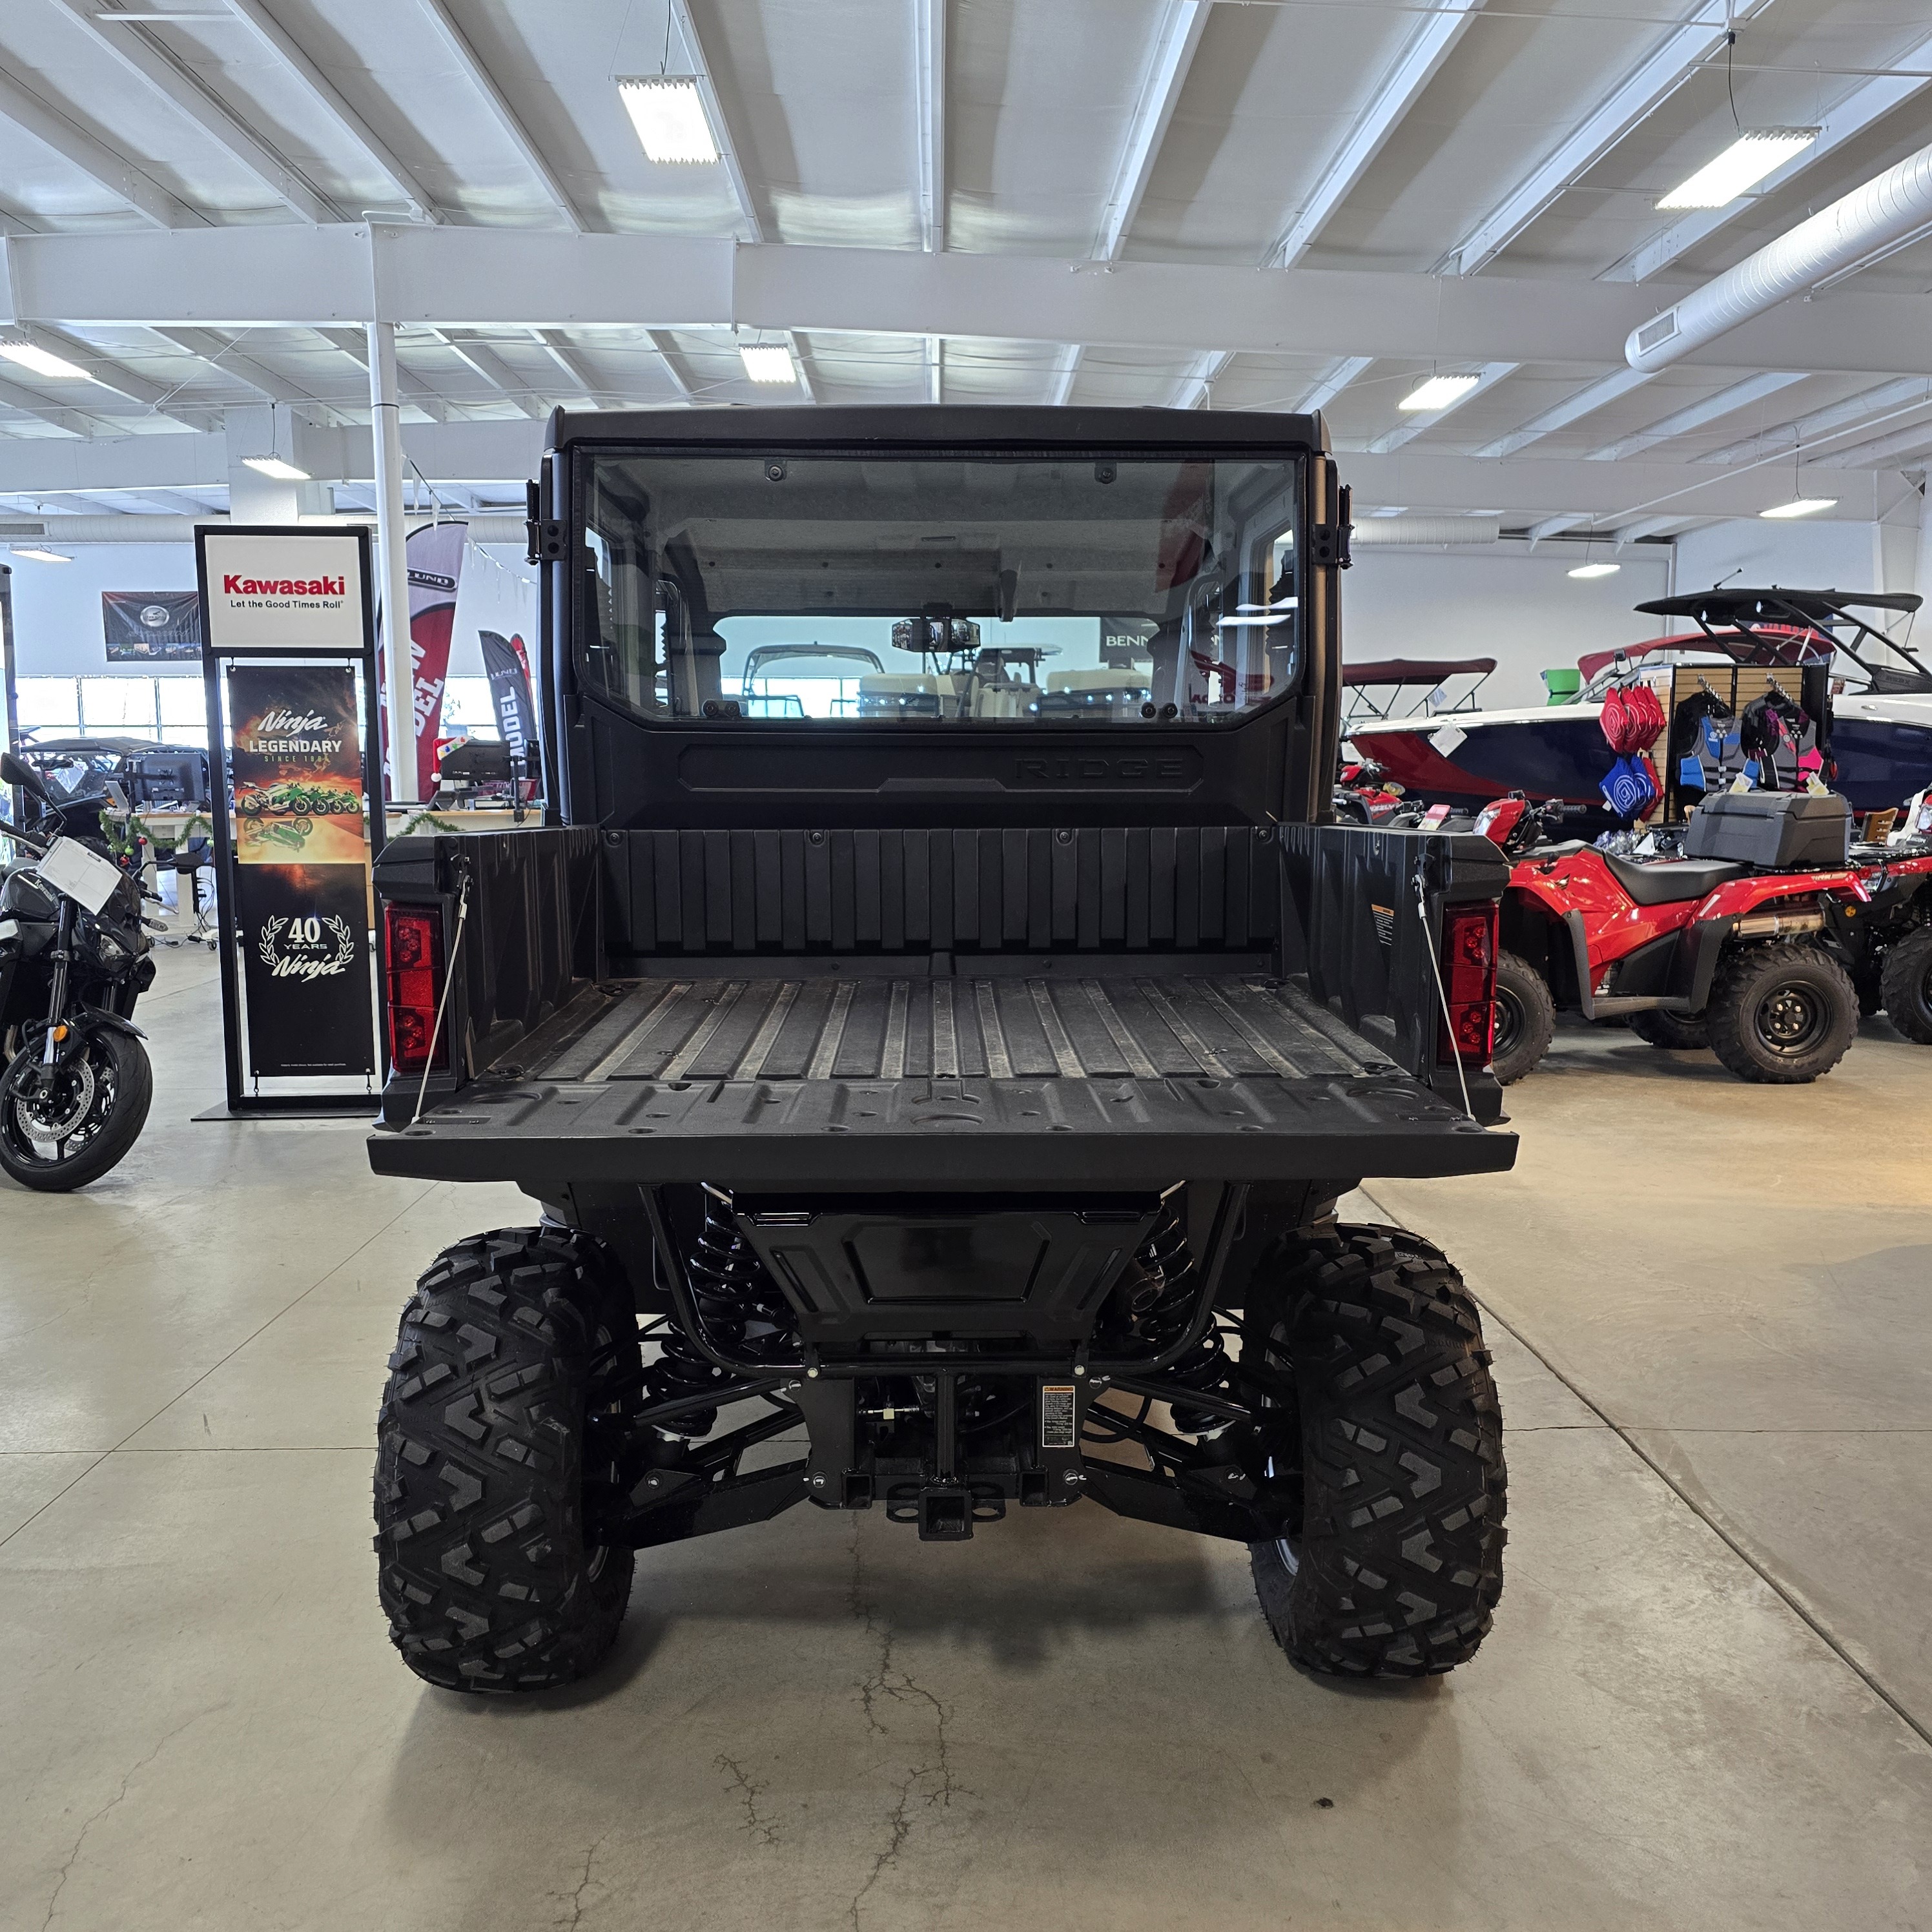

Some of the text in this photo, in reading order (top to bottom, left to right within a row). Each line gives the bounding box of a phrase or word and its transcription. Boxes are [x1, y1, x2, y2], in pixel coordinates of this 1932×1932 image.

[223, 574, 345, 595] Kawasaki
[258, 709, 328, 737] Ninja
[249, 740, 342, 753] LEGENDARY
[1015, 759, 1183, 778] RIDGE
[288, 918, 321, 943] 40
[272, 954, 346, 983] Ninja
